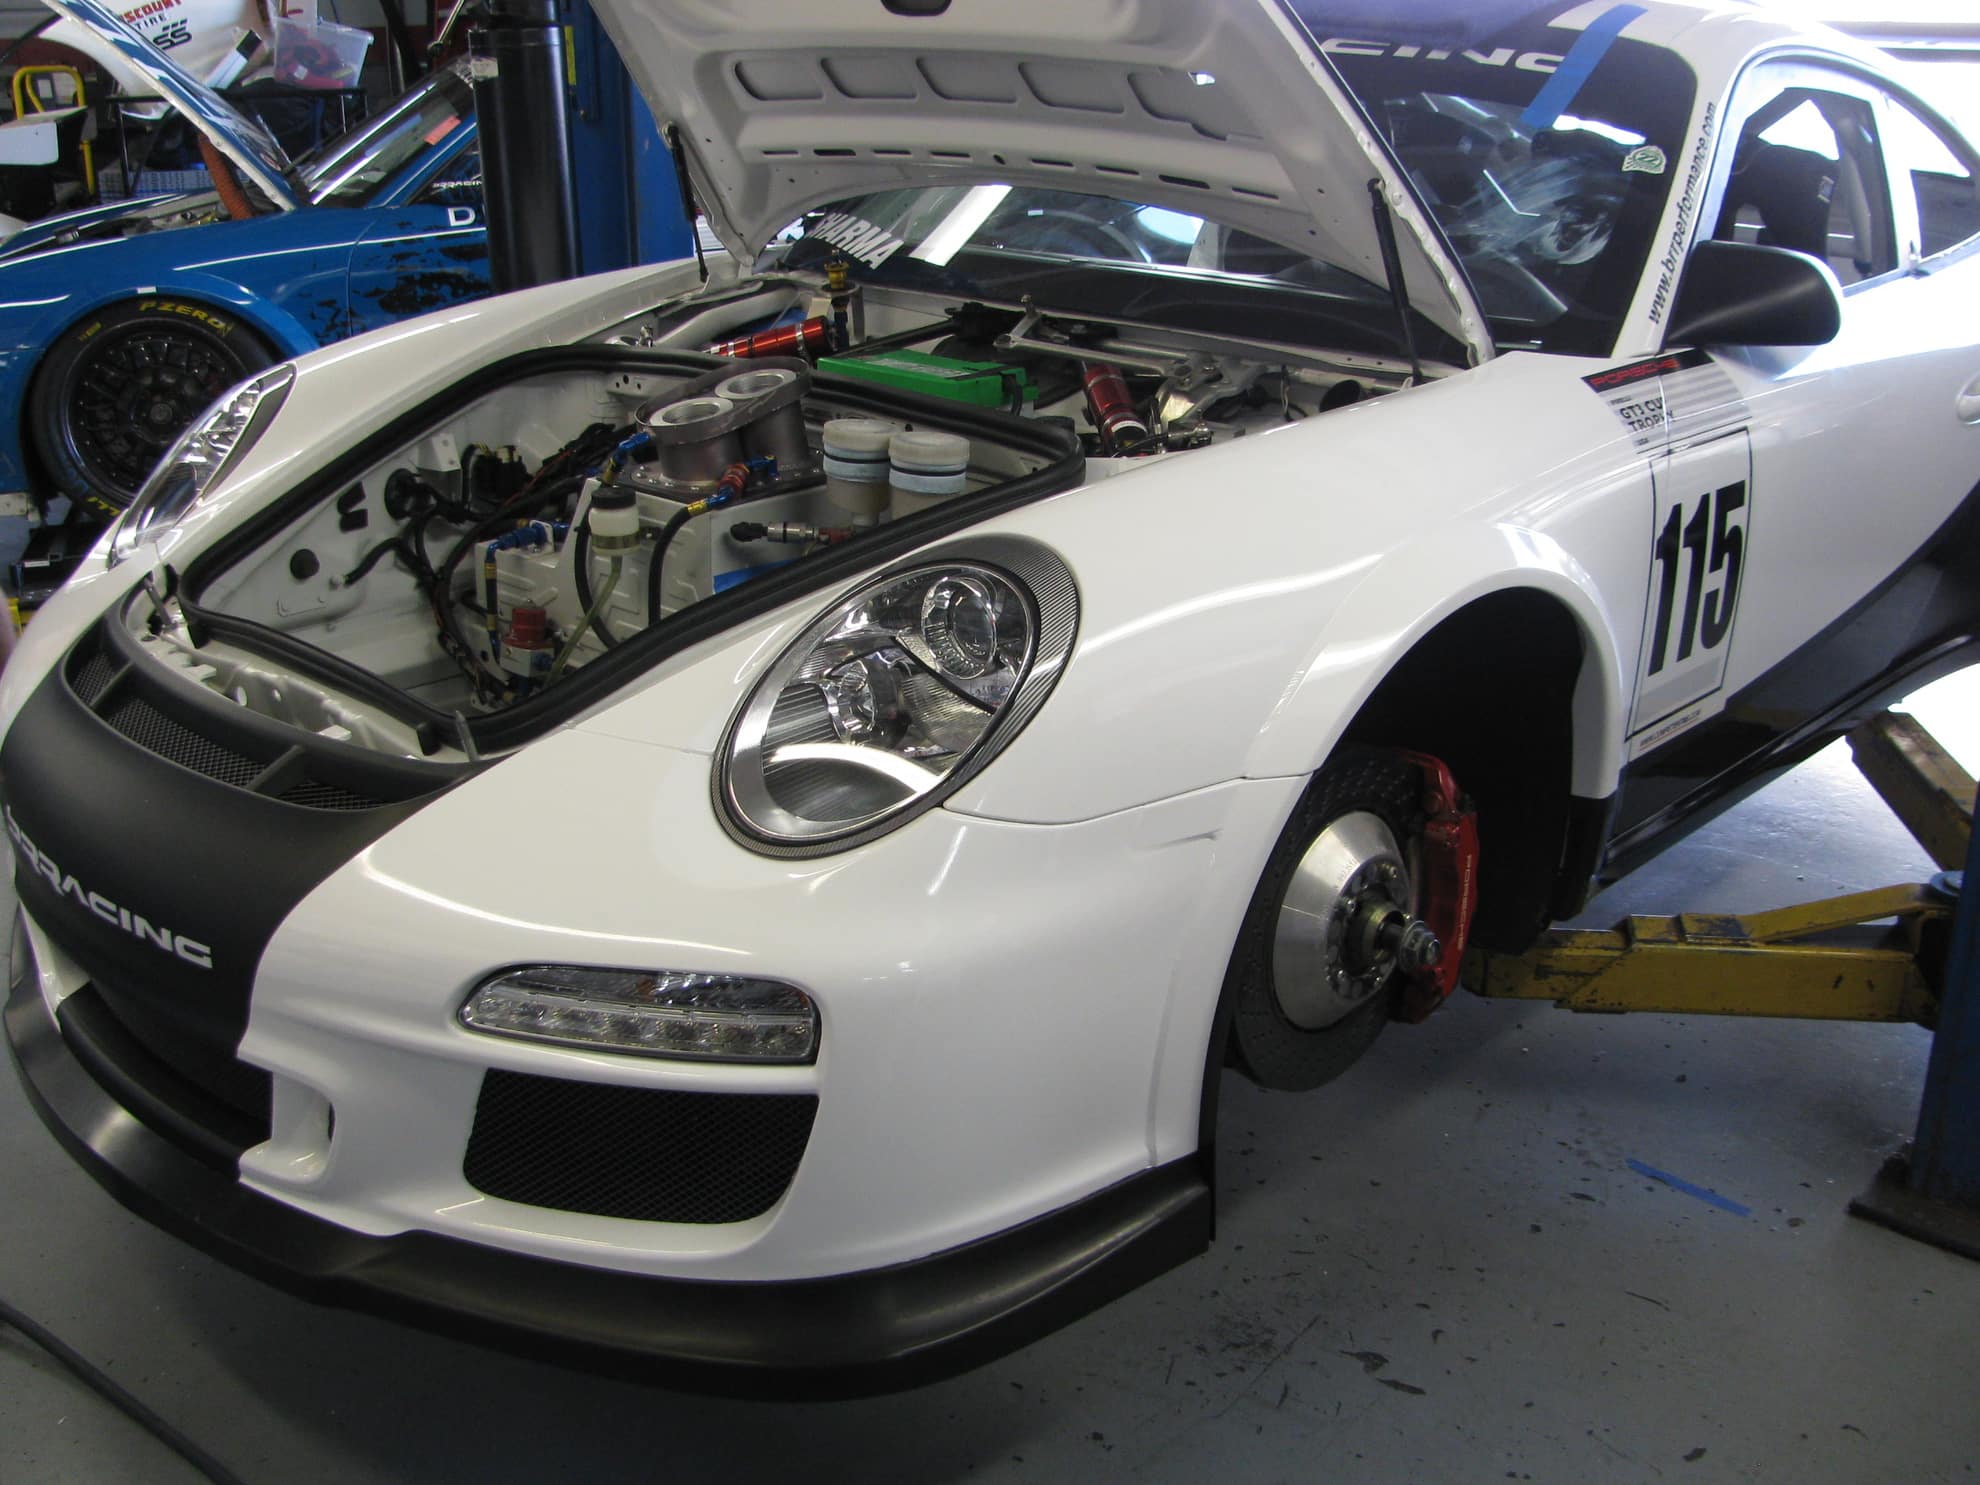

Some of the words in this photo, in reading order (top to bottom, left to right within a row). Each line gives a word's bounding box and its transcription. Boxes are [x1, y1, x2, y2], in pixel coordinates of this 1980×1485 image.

[1648, 102, 1716, 325] www.brrperformance.com
[1590, 358, 1680, 388] PORSCHE
[1619, 404, 1645, 420] GT3
[1627, 410, 1674, 432] TROPY
[1647, 480, 1746, 677] 115
